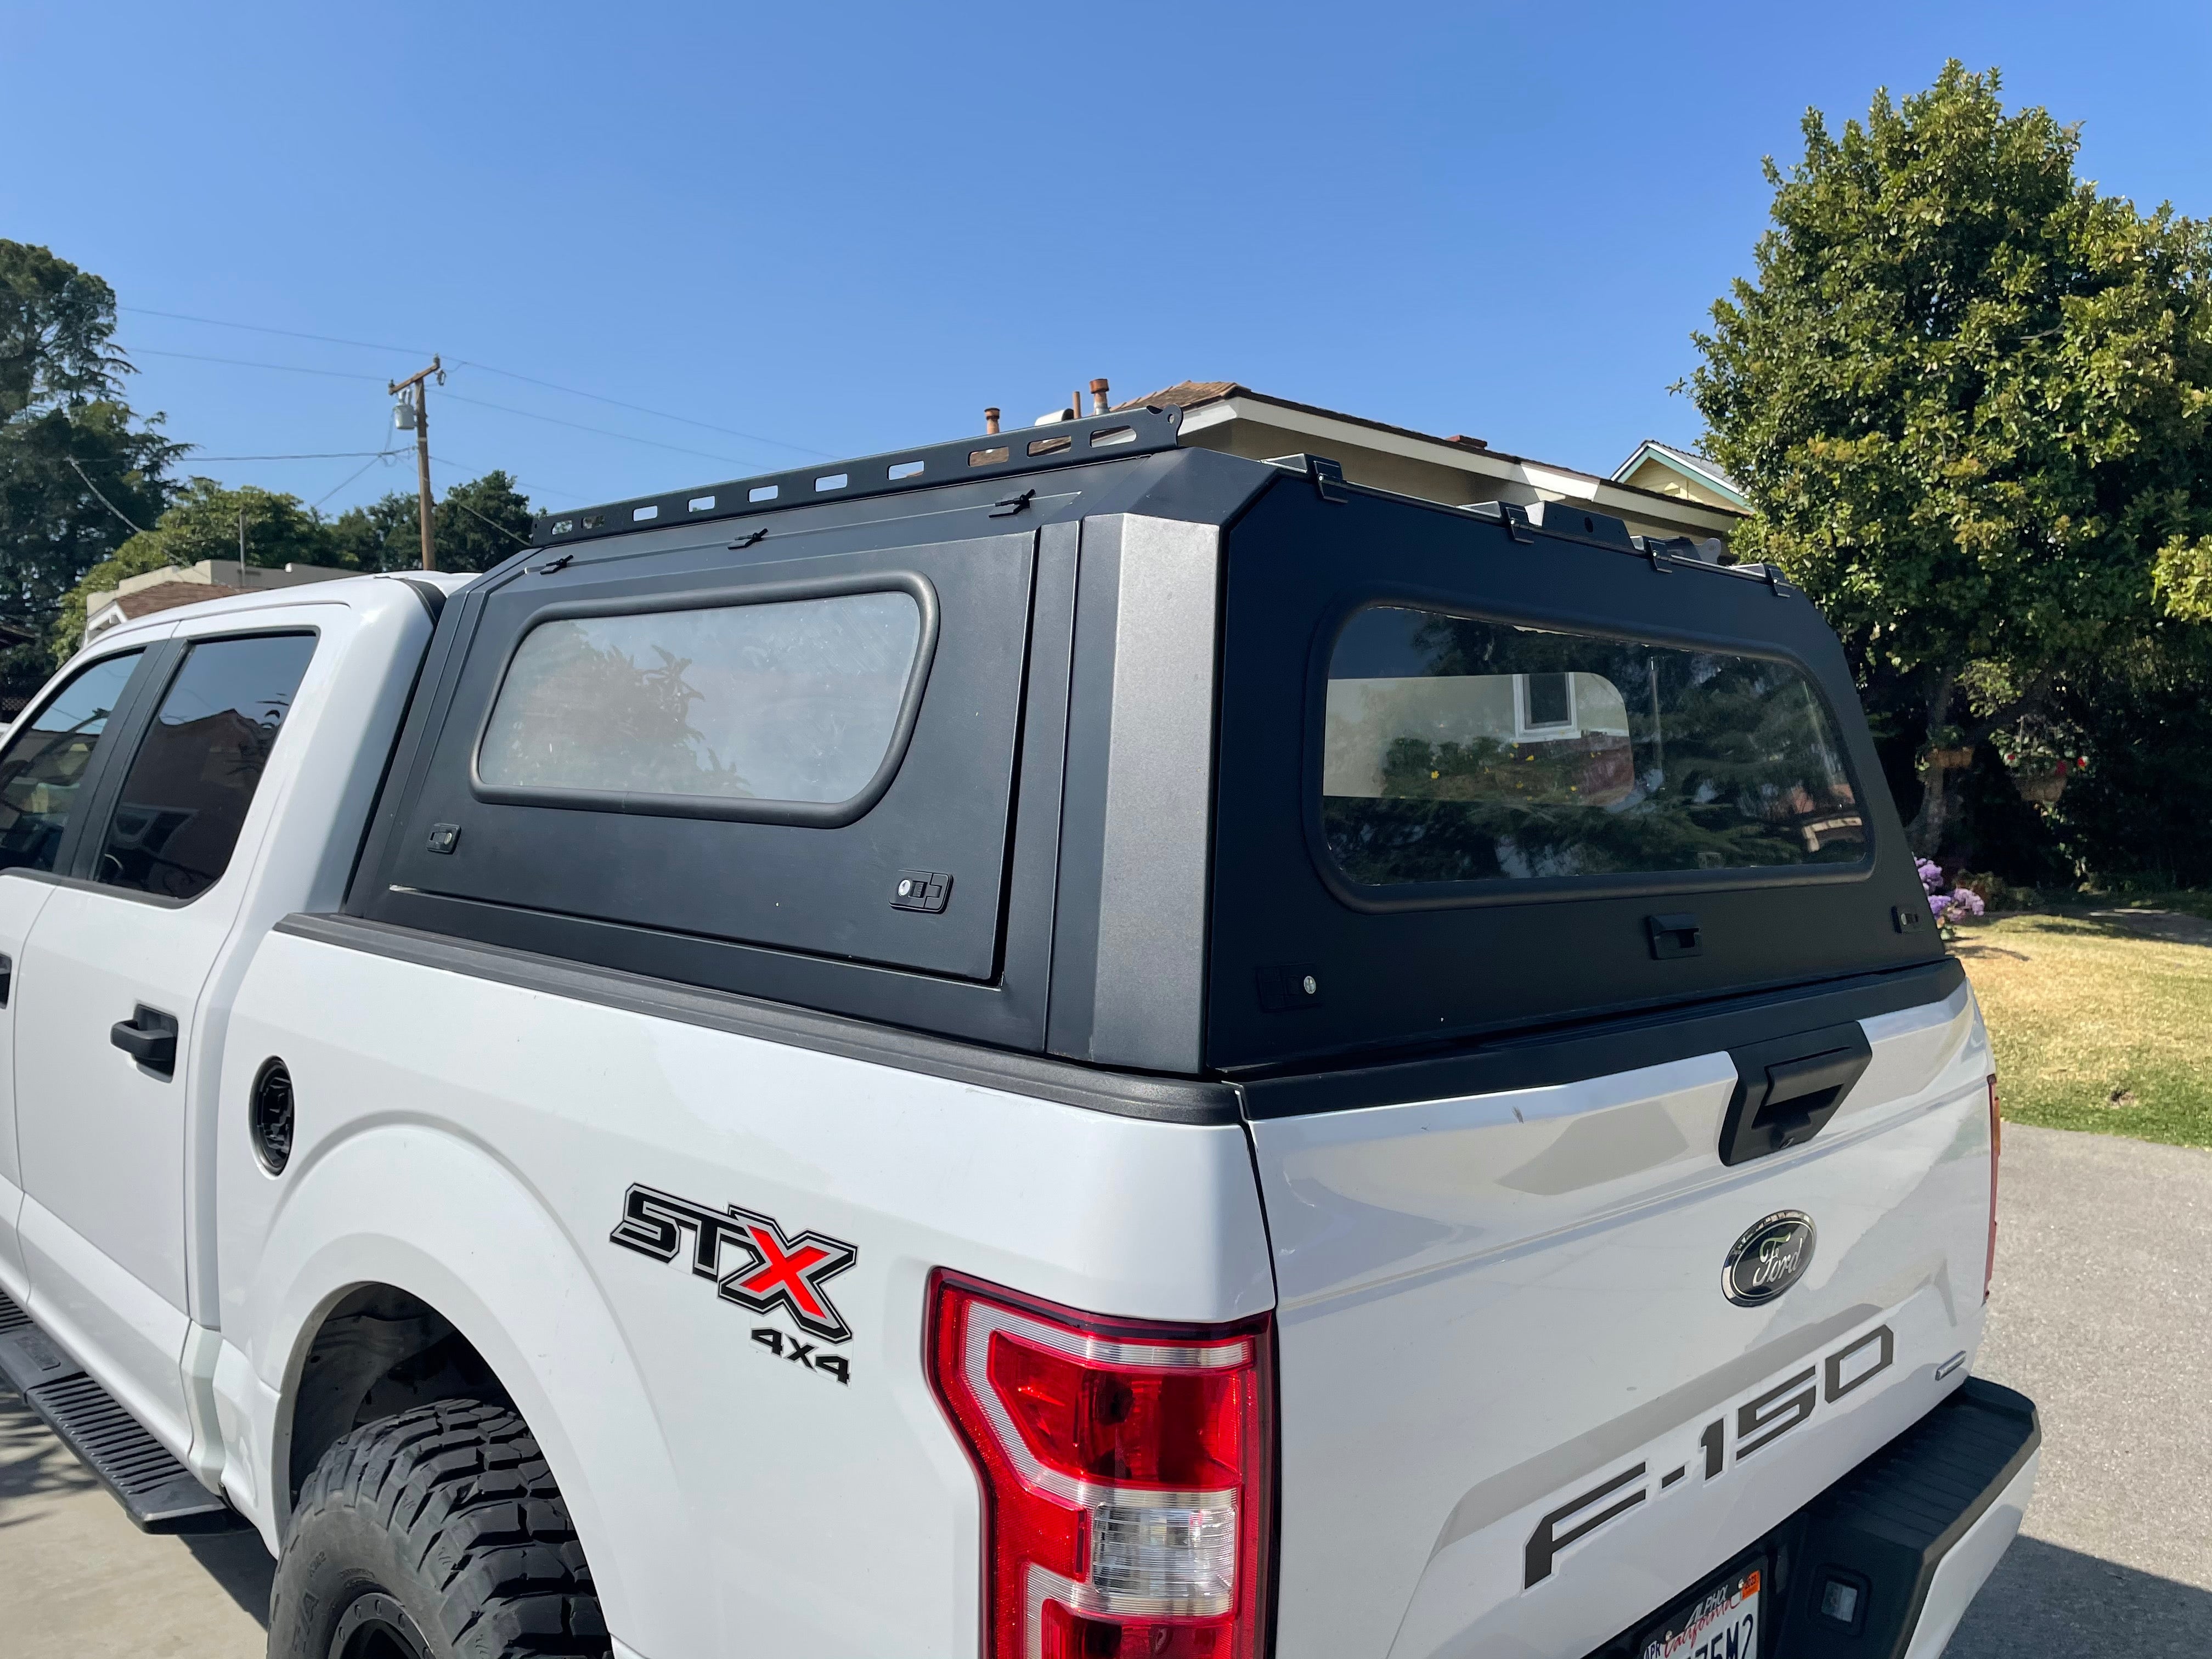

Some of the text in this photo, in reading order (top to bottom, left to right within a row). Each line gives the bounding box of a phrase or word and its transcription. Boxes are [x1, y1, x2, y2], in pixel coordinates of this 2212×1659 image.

[609, 1181, 860, 1346] STX
[1752, 1232, 1803, 1286] Ford
[1524, 1324, 1894, 1590] F-150
